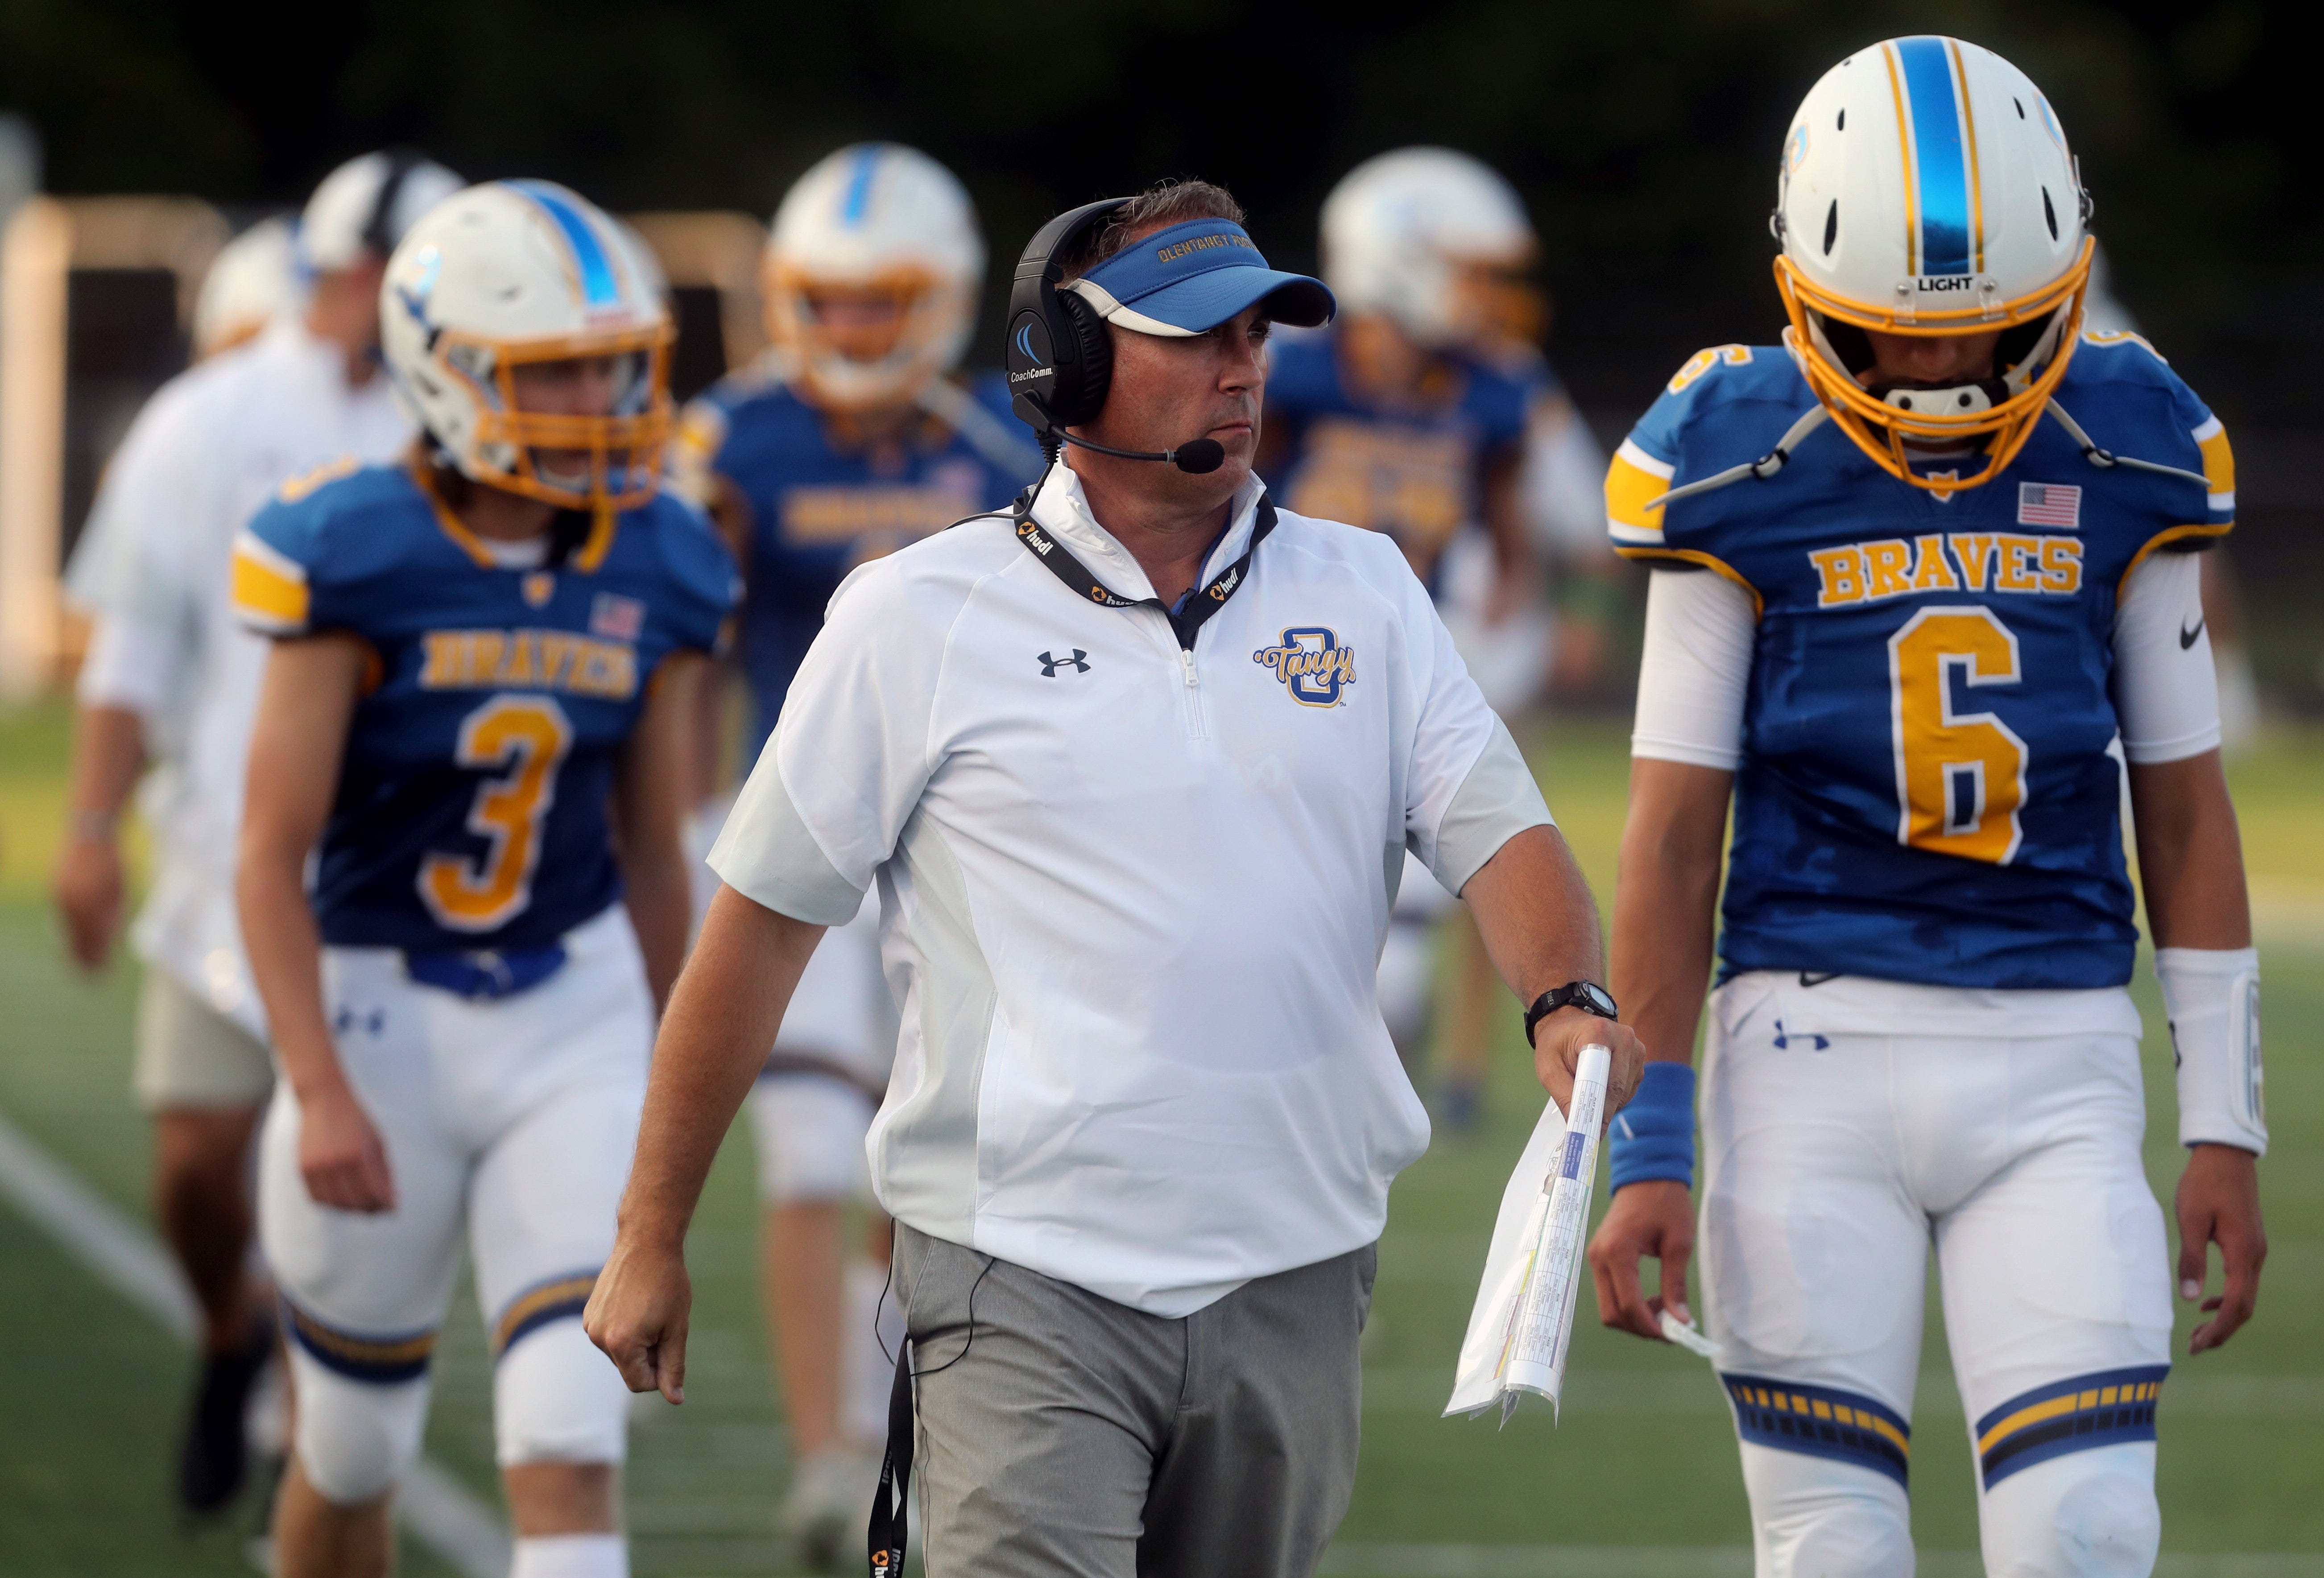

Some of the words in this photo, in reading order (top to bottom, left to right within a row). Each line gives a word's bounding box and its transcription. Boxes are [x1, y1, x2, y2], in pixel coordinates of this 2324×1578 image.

[1158, 234, 1229, 263] OLENTANGY
[1919, 277, 1973, 291] LIGHT
[1026, 529, 1054, 556] hudl
[1219, 567, 1238, 594] hudl
[1808, 532, 2084, 608] BRAVES
[1106, 595, 1137, 605] hu
[1253, 642, 1356, 686] Tangy
[1887, 605, 2029, 867] 6
[416, 694, 574, 934] 3
[1546, 991, 1555, 1006] TIMEX
